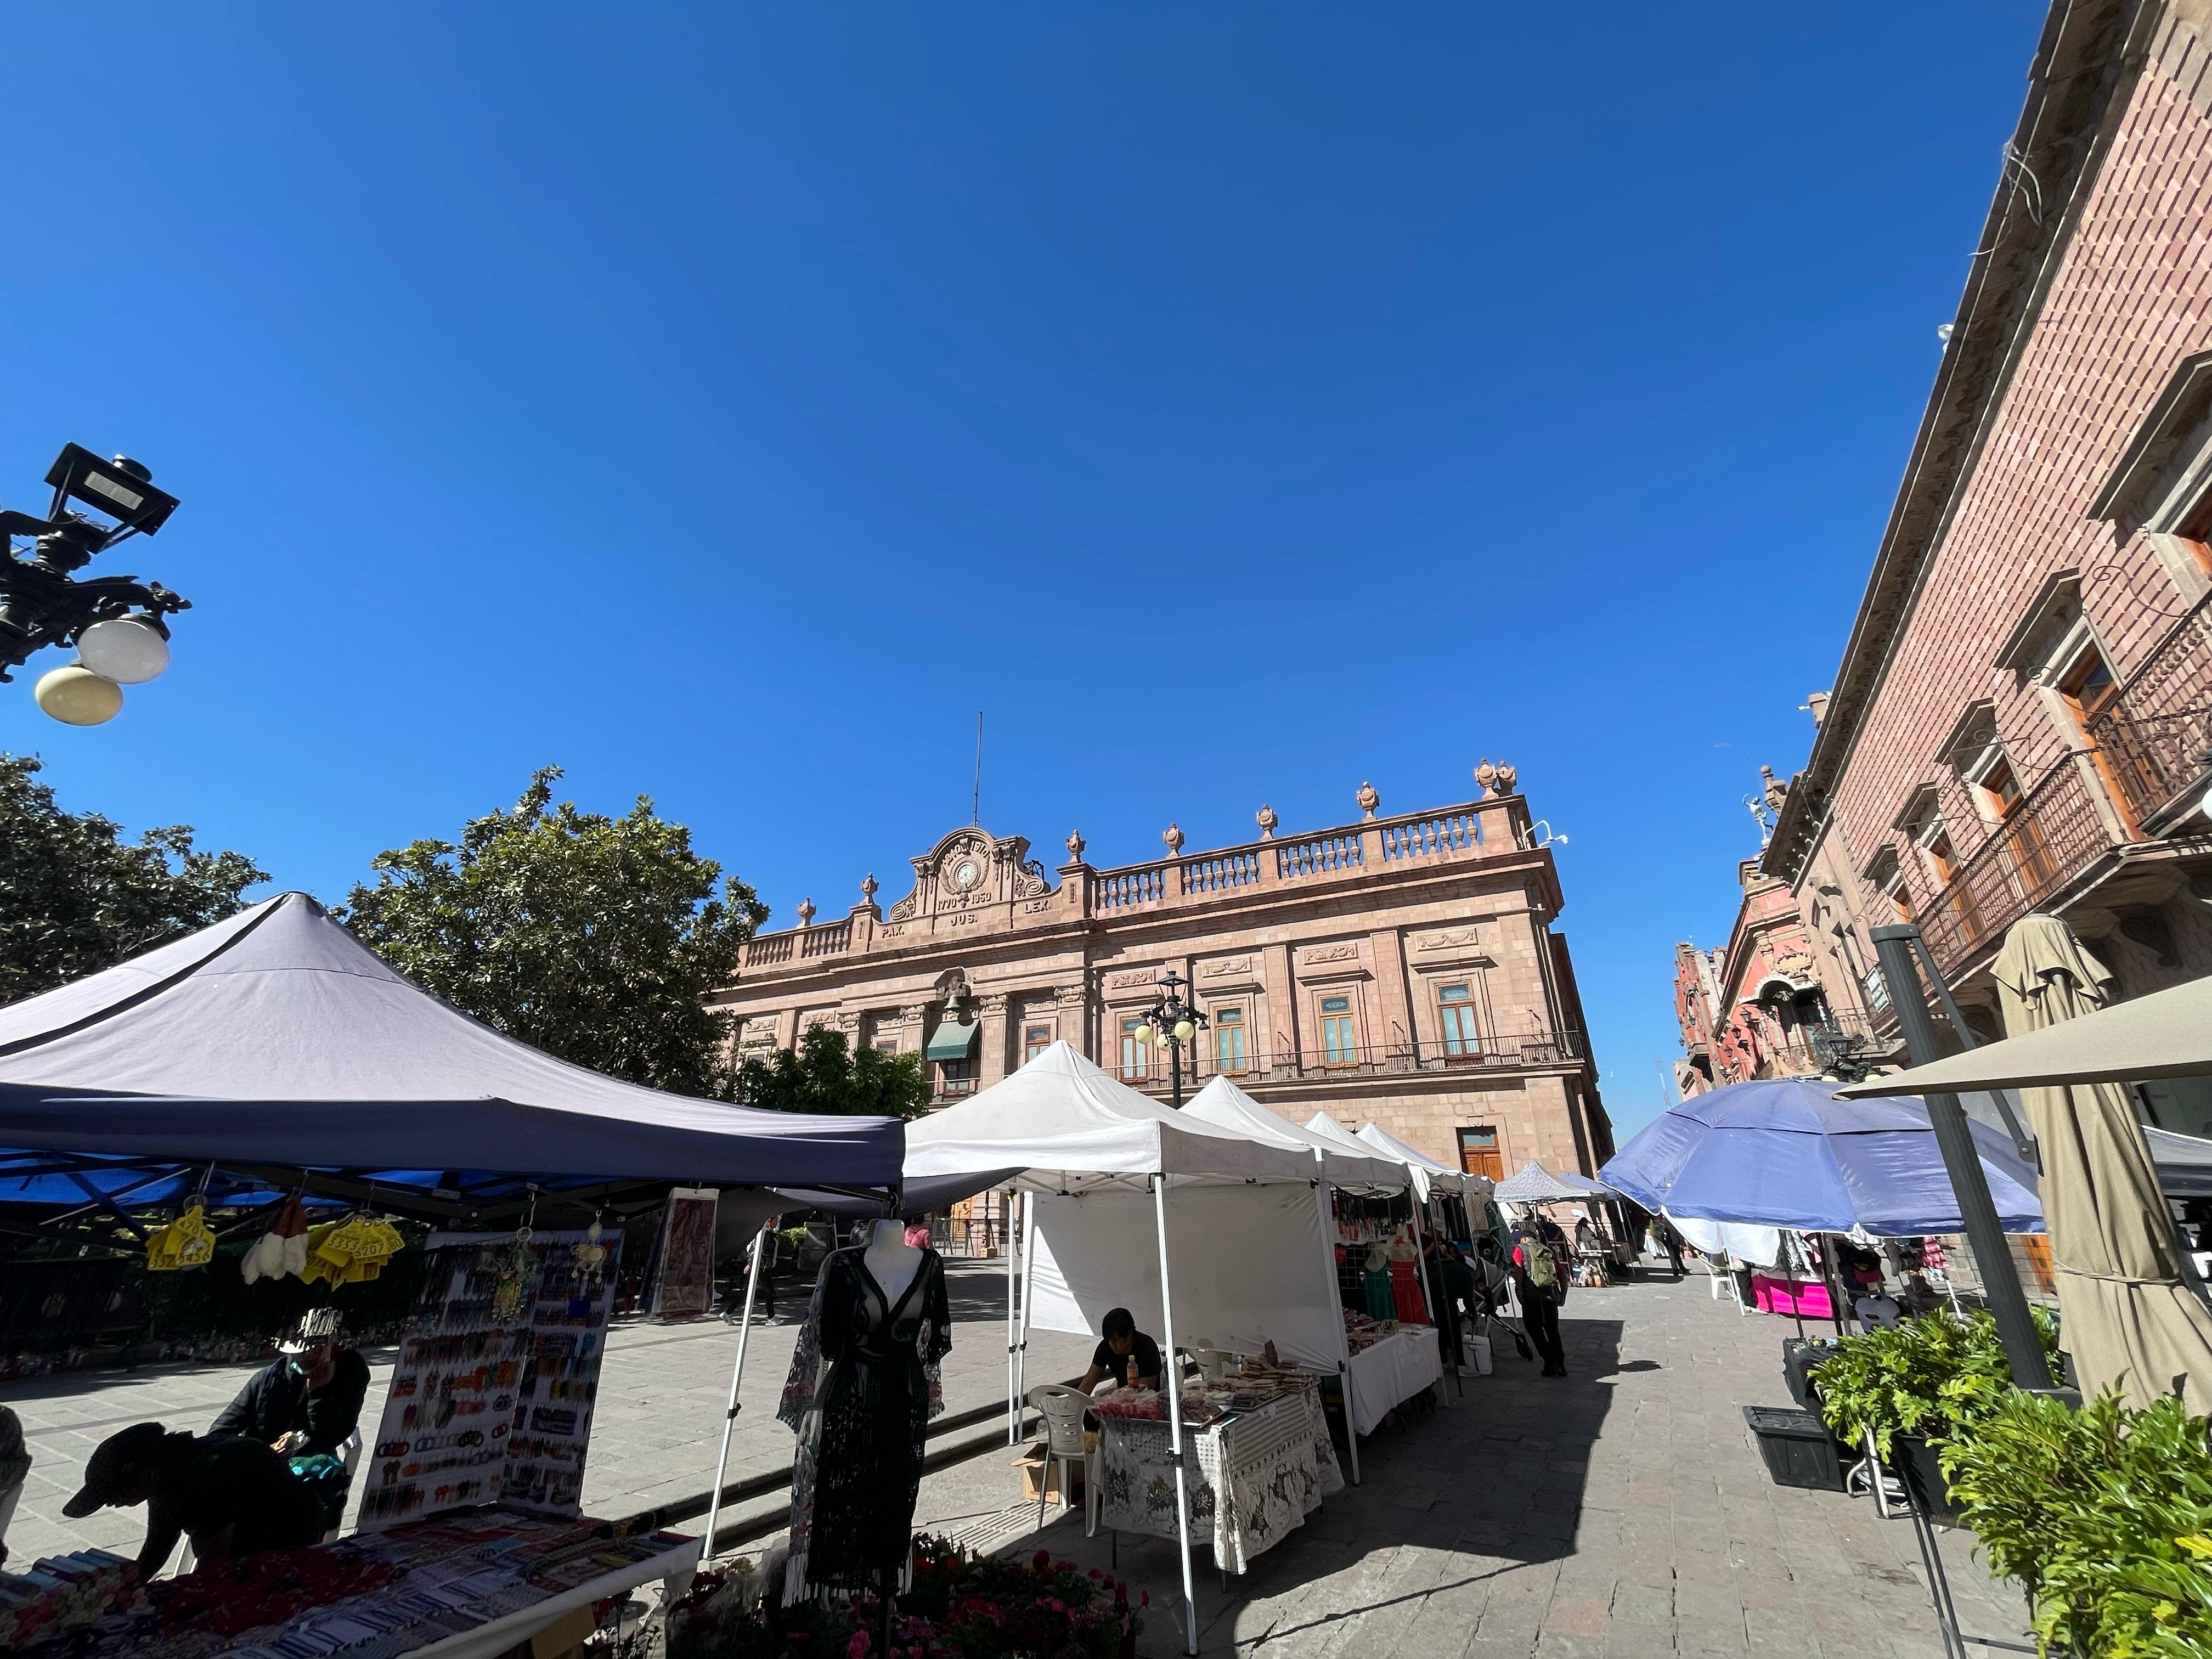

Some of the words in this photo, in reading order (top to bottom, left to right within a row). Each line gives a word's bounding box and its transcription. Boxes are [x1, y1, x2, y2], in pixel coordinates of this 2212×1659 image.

[969, 840, 990, 859] 1910
[937, 898, 957, 911] 1770
[882, 925, 905, 939] PAX.
[950, 913, 978, 927] JUS.
[1024, 900, 1051, 914] LEX.
